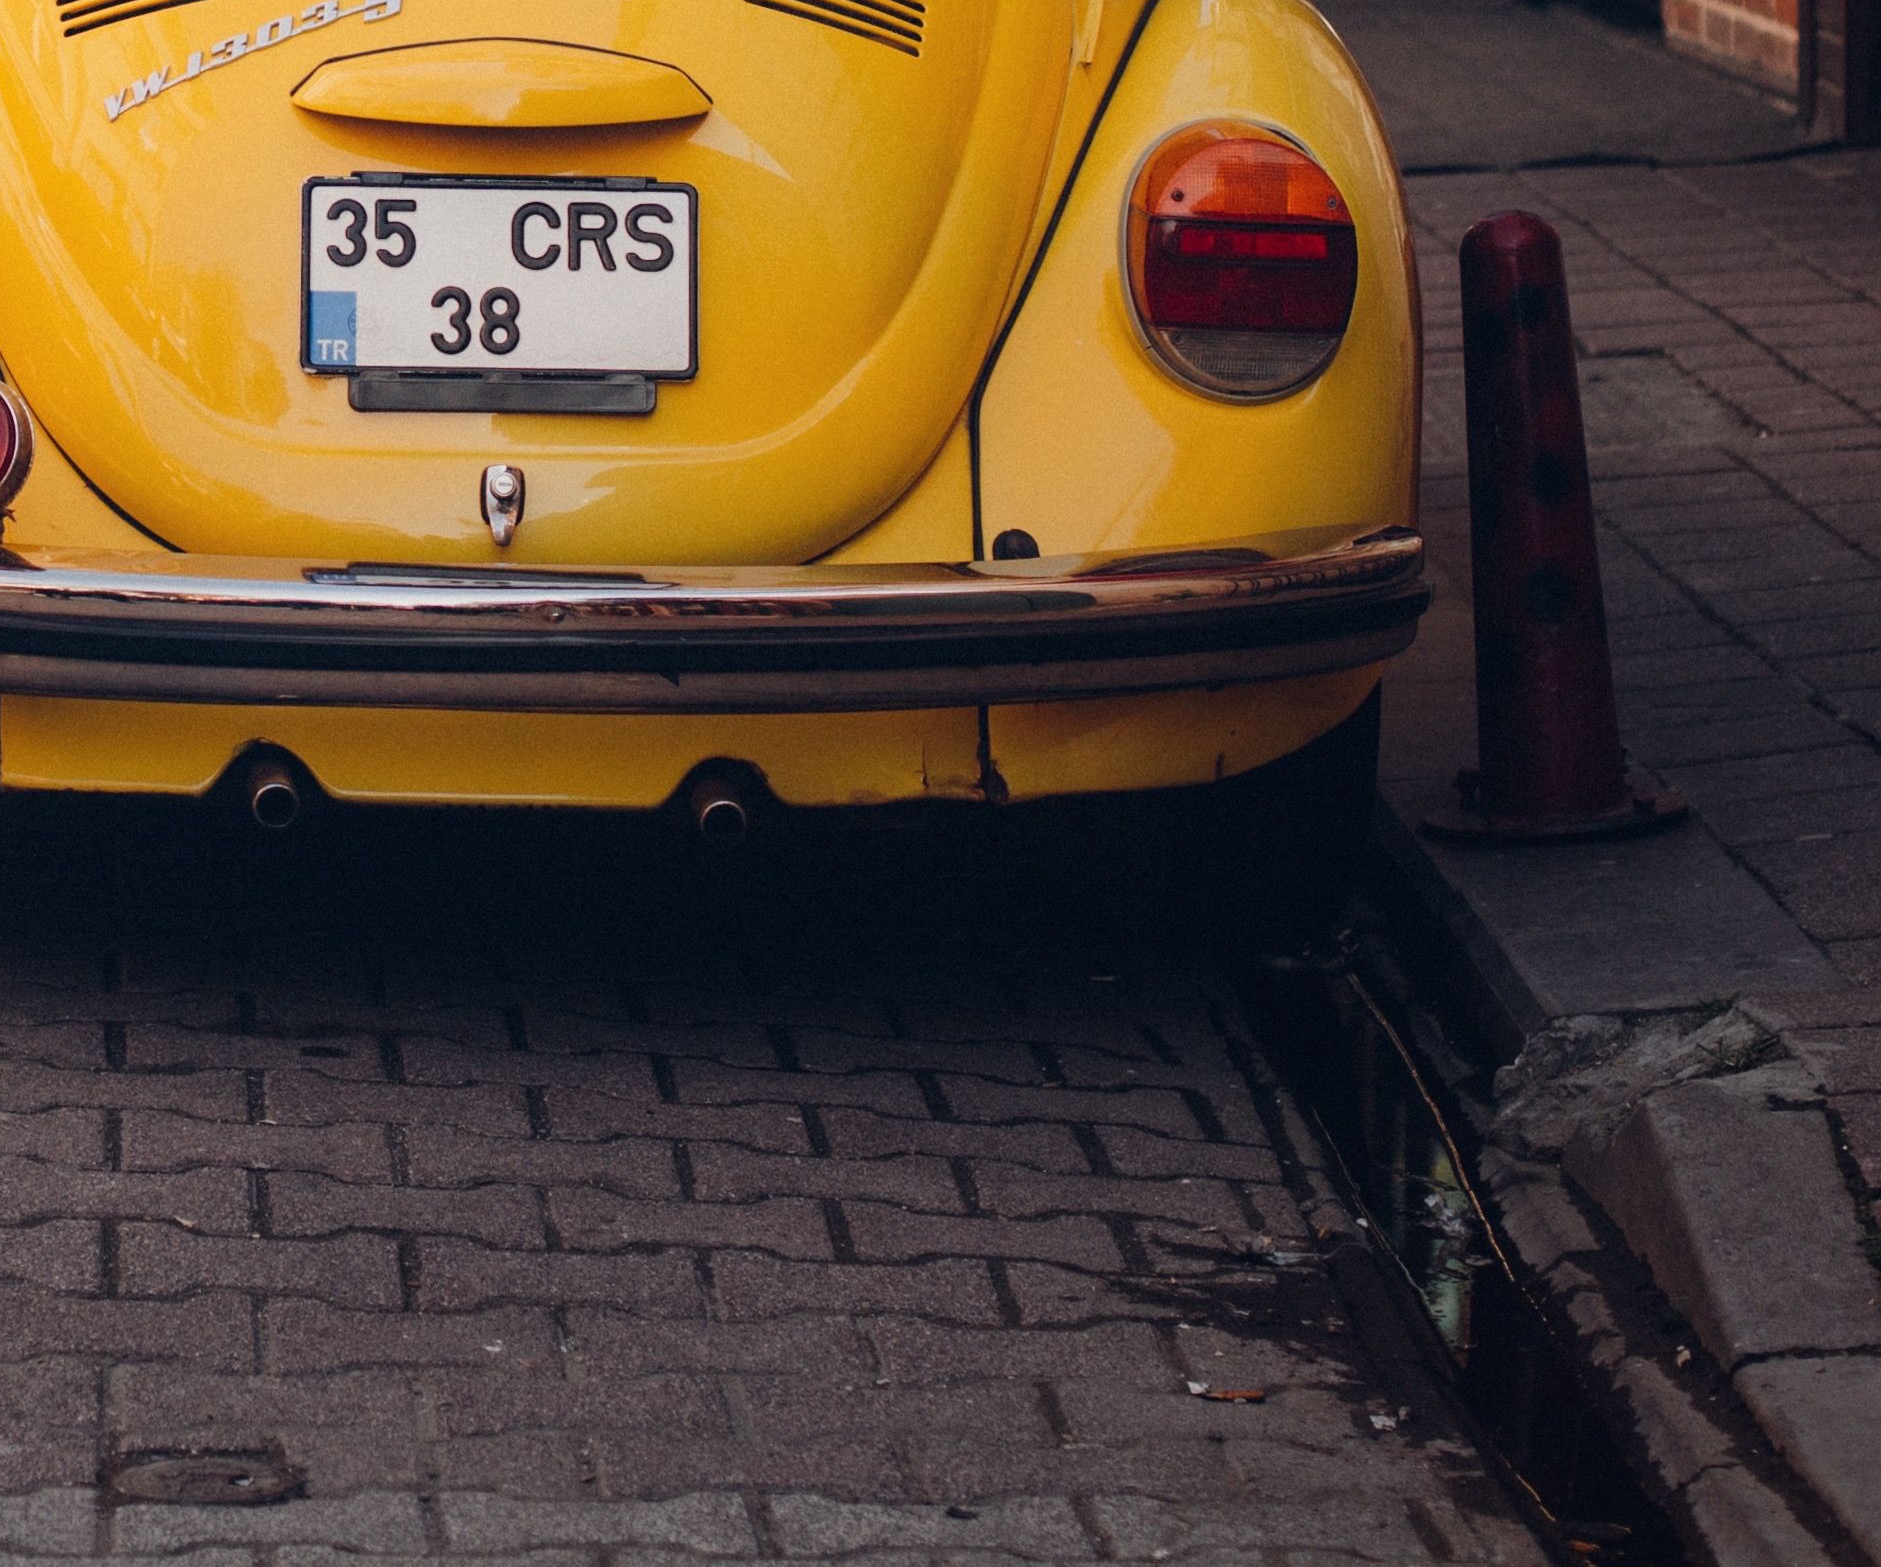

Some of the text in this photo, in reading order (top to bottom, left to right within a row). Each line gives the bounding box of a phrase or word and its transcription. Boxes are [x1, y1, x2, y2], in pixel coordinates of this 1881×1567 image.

[326, 198, 675, 273] 35 CRS
[316, 339, 349, 362] TR
[430, 285, 521, 356] 38
